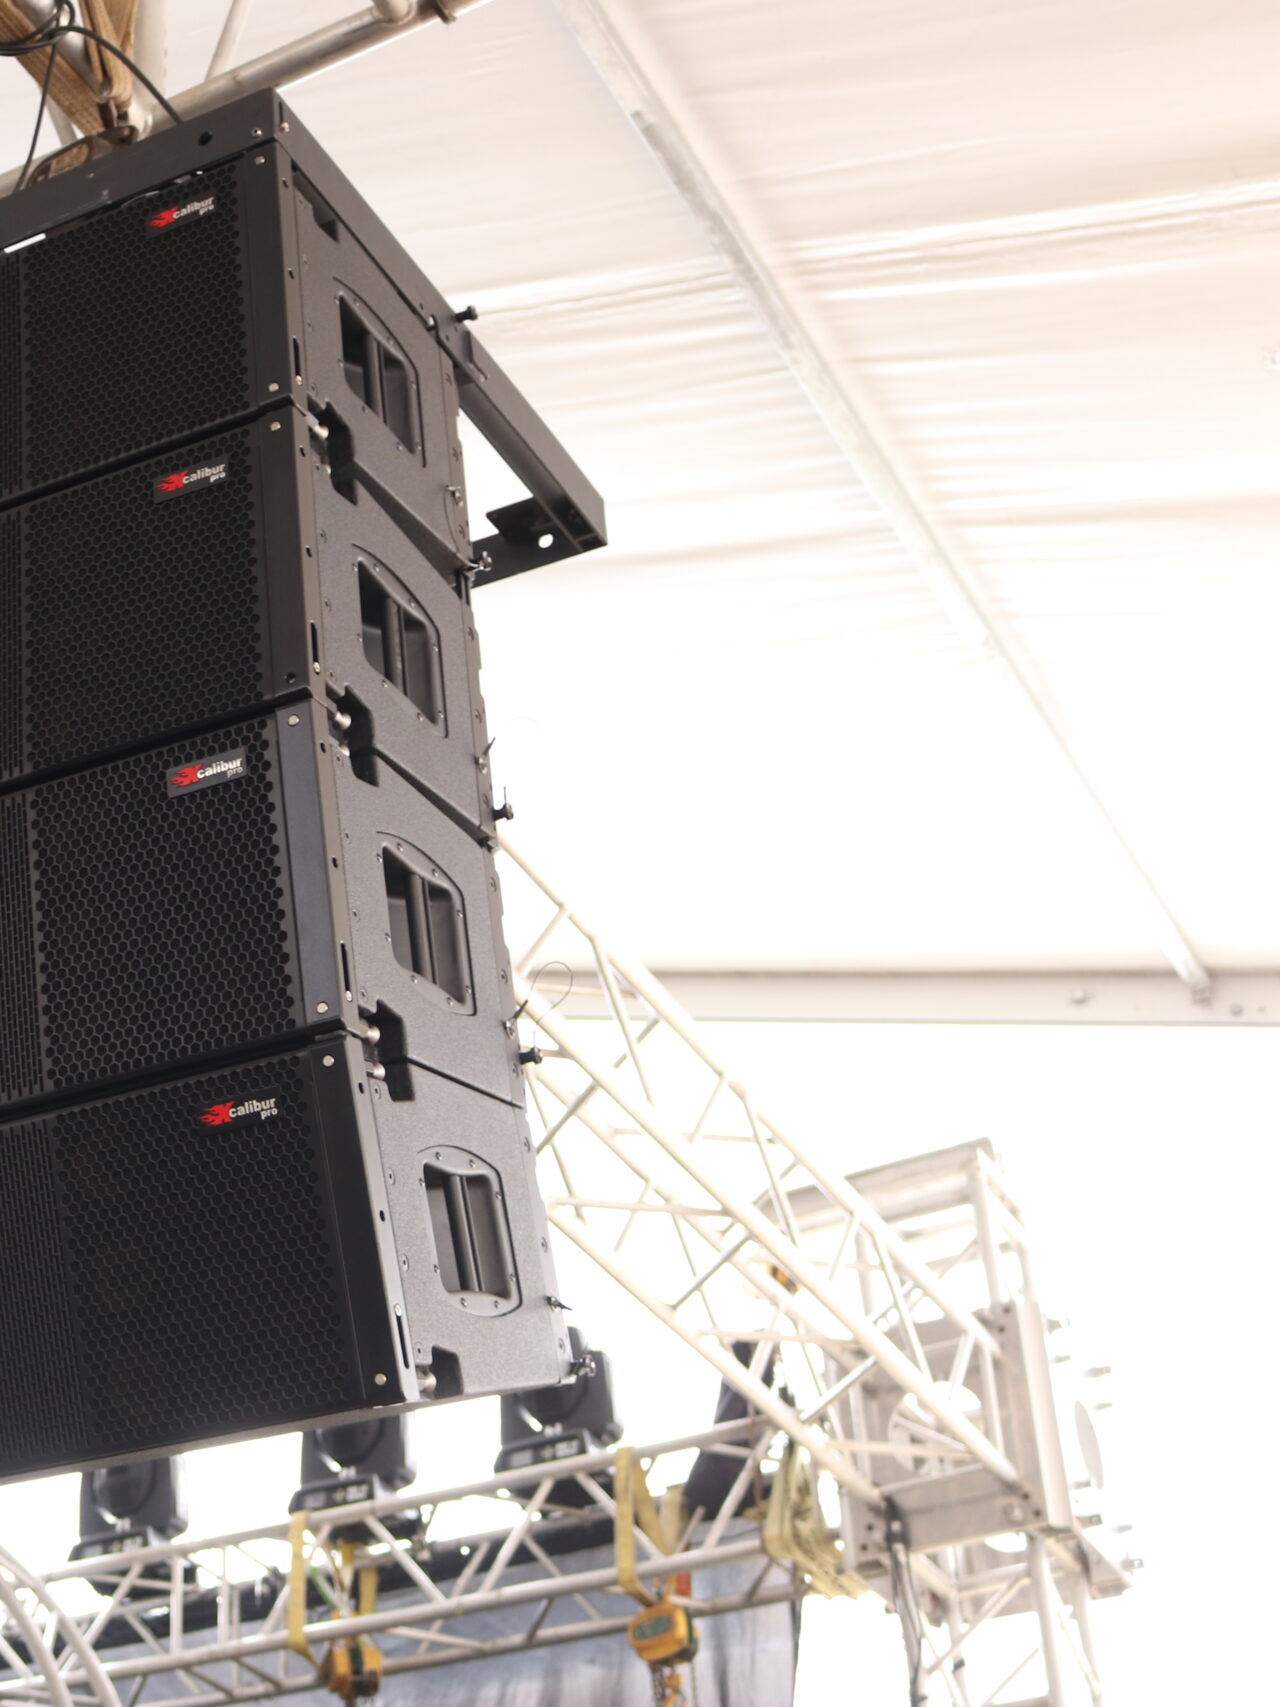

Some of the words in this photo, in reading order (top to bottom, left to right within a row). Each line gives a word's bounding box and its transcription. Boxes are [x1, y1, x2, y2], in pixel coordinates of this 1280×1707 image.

[209, 471, 226, 483] pro
[227, 765, 244, 779] pro
[260, 1107, 279, 1121] pro
